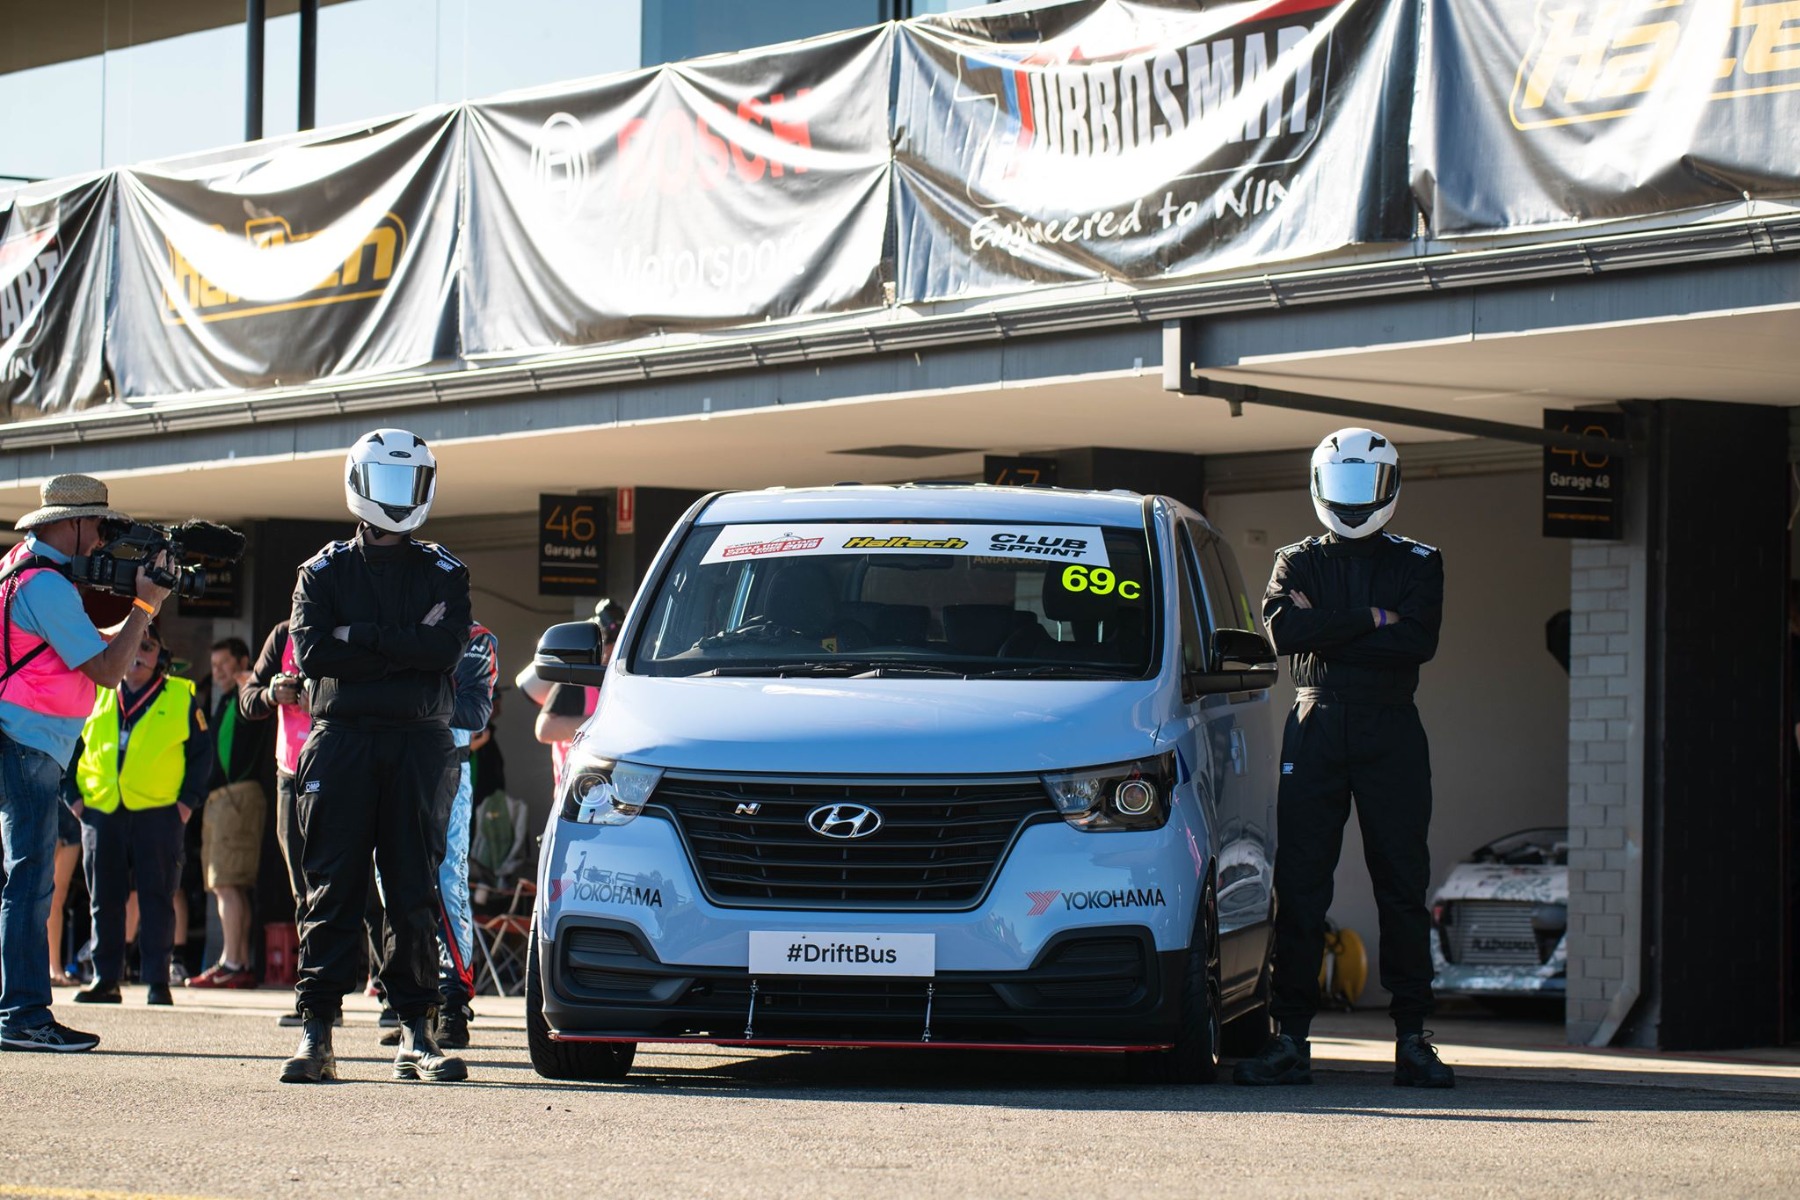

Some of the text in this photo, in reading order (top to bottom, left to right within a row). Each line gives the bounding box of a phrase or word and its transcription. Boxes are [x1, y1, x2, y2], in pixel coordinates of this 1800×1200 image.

[970, 200, 1142, 256] Engineered
[1157, 191, 1199, 229] to
[1550, 471, 1610, 491] Garage 48
[545, 505, 596, 541] 46
[544, 542, 597, 559] Garage 46
[842, 536, 969, 551] Haltech
[988, 543, 1088, 558] SPRINT
[990, 533, 1088, 549] CLUB
[735, 802, 761, 816] N
[573, 881, 662, 907] YOKOHAMA
[1062, 888, 1167, 911] YOKOHAMA
[787, 943, 897, 963] #DriftBus
